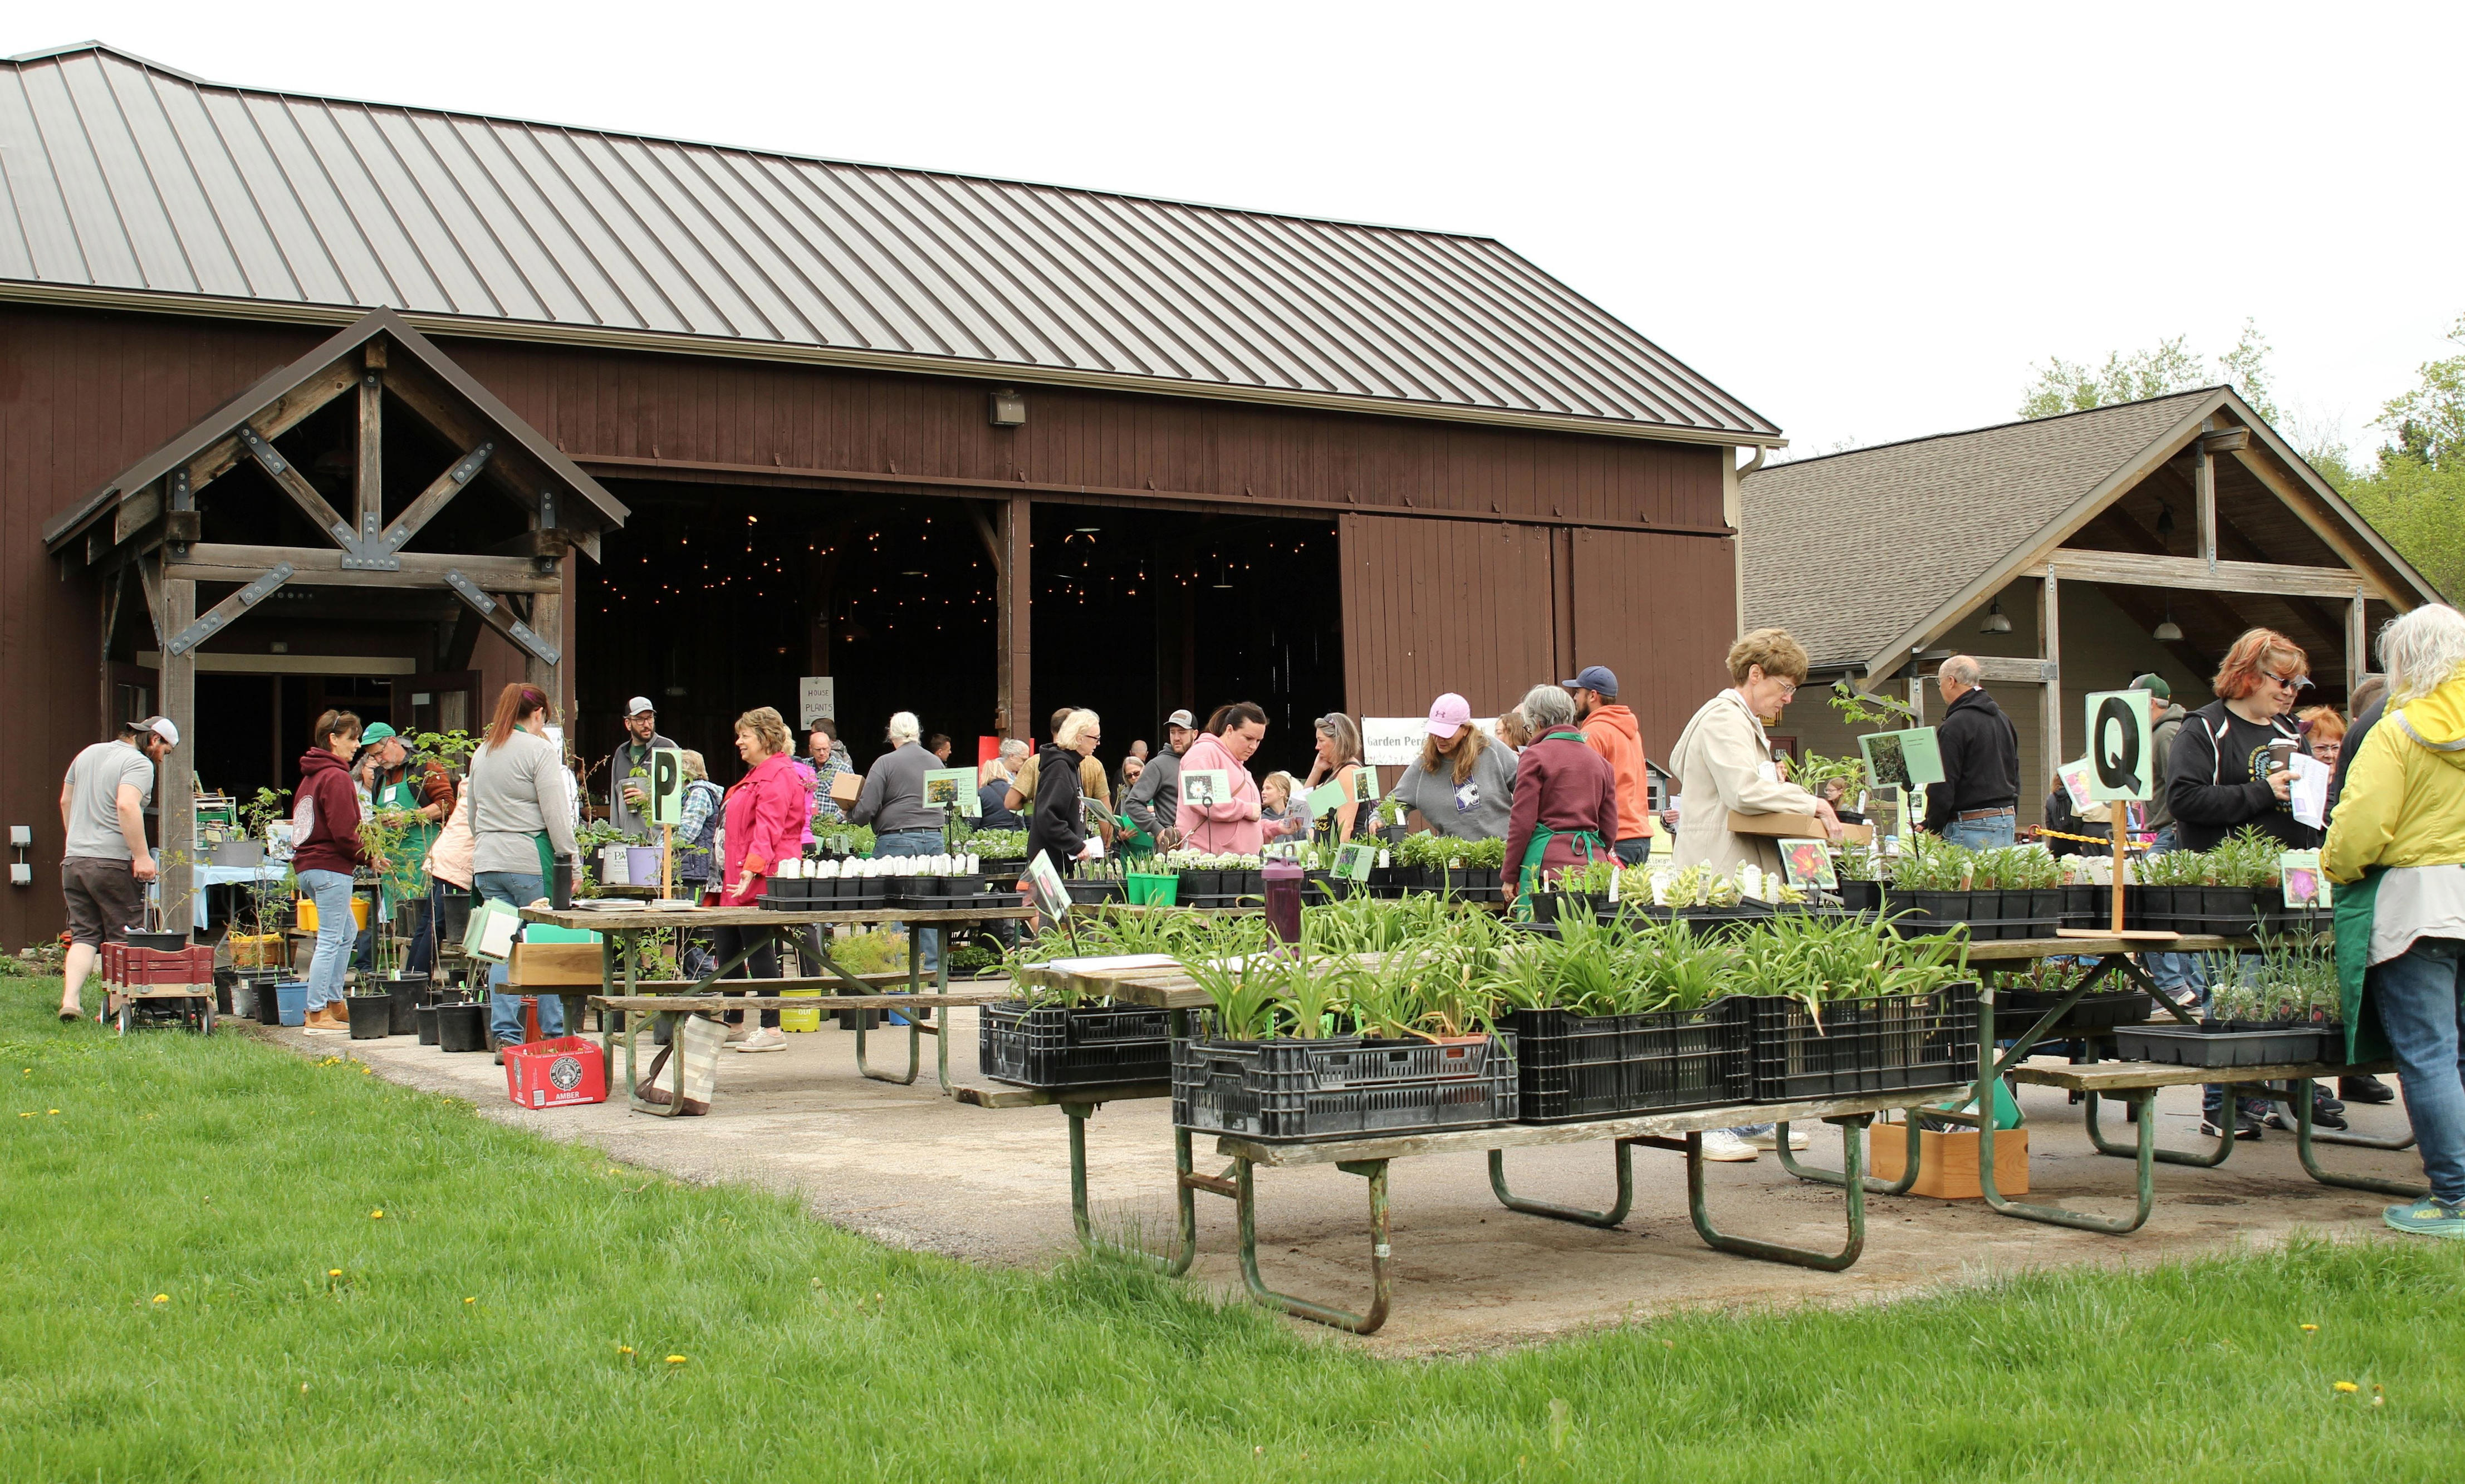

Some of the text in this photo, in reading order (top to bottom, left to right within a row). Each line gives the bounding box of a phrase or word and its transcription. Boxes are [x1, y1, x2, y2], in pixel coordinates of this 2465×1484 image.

[806, 703, 833, 712] PLANTS
[1367, 736, 1401, 746] Garden
[2094, 697, 2142, 796] Q
[655, 751, 677, 821] P
[551, 1058, 581, 1074] WOODCHUCK
[552, 1075, 563, 1088] HARD
[571, 1073, 581, 1086] CIDER
[556, 1091, 580, 1100] AMBER
[2412, 1208, 2442, 1218] HOKA
